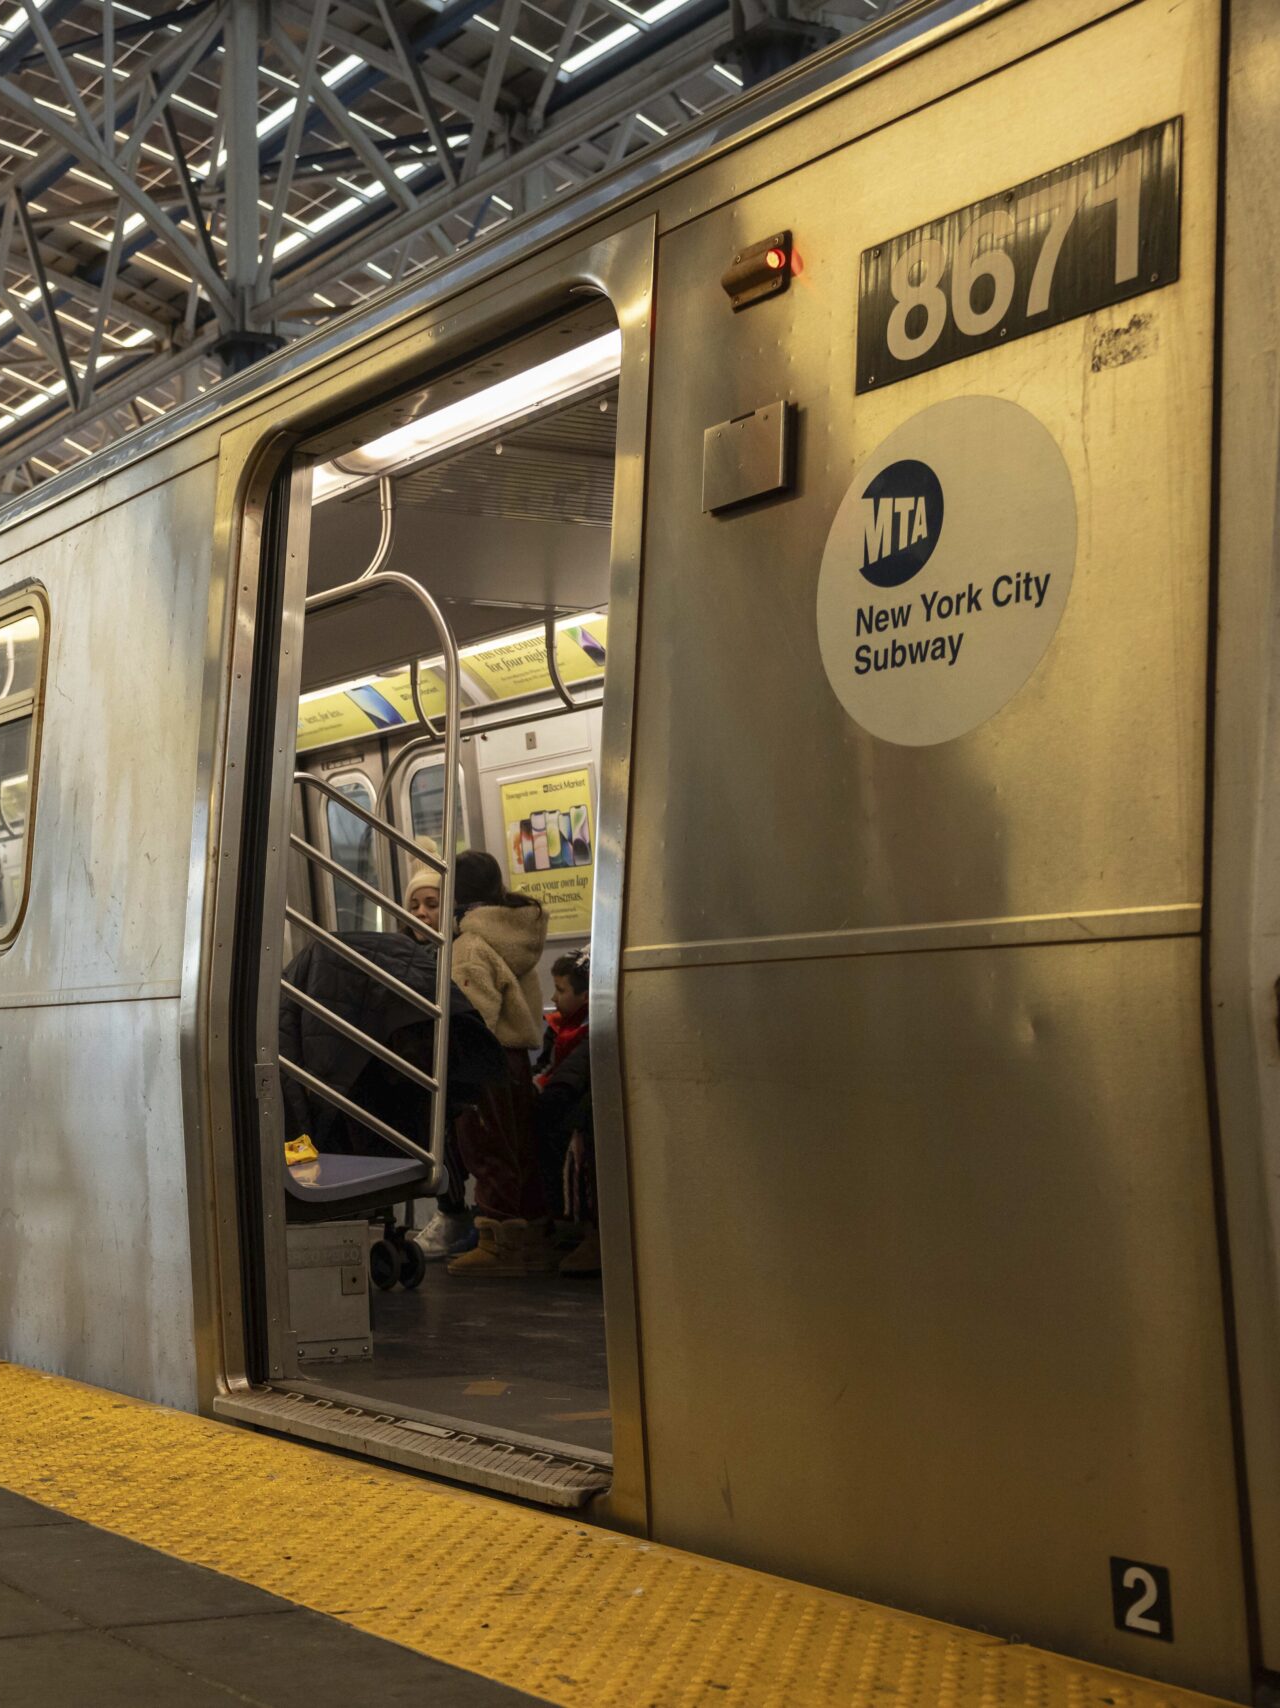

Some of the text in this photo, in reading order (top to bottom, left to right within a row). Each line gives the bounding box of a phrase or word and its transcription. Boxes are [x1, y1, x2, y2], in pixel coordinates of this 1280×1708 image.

[886, 149, 1142, 361] 8671
[860, 496, 928, 566] MTA
[855, 571, 1052, 637] New York City
[854, 632, 965, 676] Subway
[576, 874, 589, 889] lap
[1122, 1566, 1161, 1635] 2
